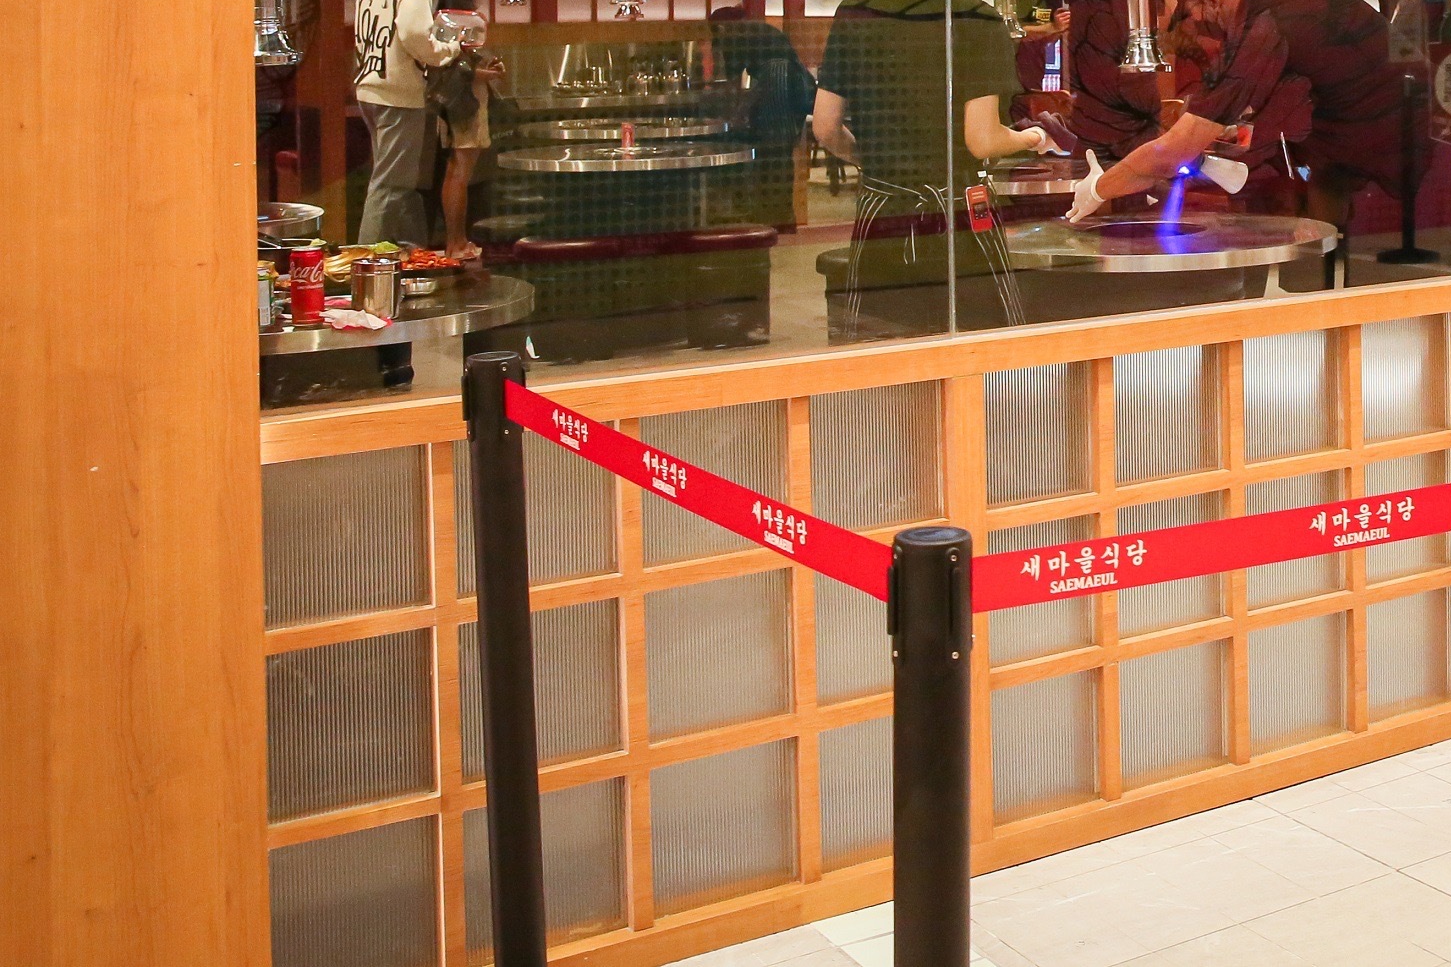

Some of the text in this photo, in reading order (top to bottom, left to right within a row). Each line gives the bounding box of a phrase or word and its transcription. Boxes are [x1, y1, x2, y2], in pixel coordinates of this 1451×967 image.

[752, 500, 808, 545] 새마을식당
[1308, 496, 1416, 536] 새마을식당
[1333, 526, 1390, 548] SAEMAEUL
[1020, 540, 1148, 582] 새마을식당
[1049, 571, 1118, 594] SAEMAEUL
